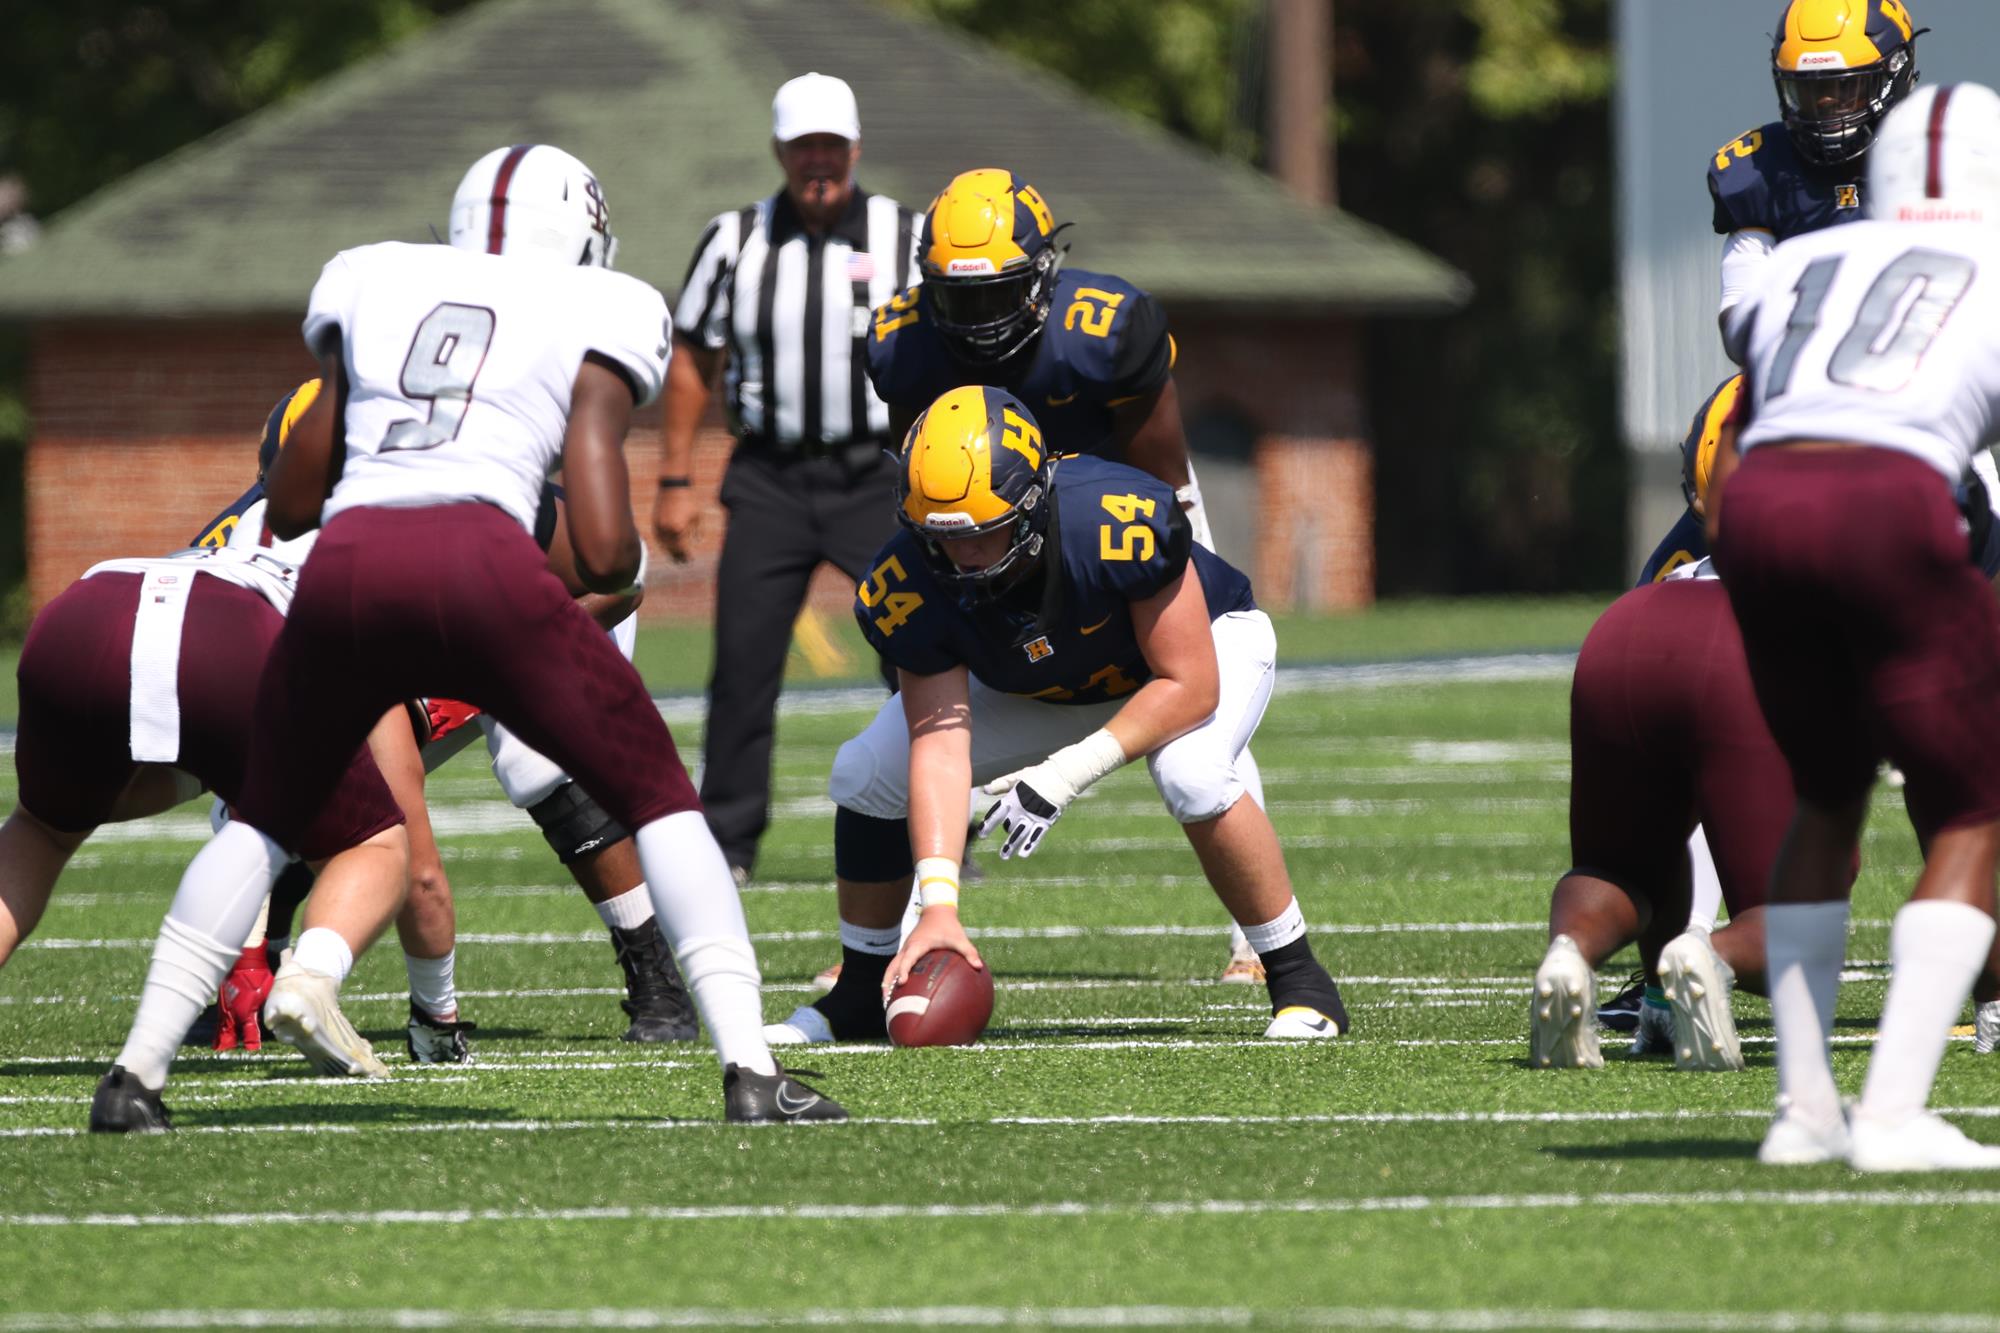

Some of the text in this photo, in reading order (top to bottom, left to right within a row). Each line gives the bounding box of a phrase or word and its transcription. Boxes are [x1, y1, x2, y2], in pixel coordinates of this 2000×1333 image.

[1836, 185, 1858, 208] H
[952, 262, 987, 271] Riddell
[875, 286, 919, 342] 21
[1064, 287, 1126, 338] 21
[1764, 245, 1979, 401] 10
[376, 301, 496, 454] 9
[1001, 407, 1042, 472] H
[1099, 492, 1156, 561] 54
[858, 554, 925, 638] 54
[1024, 636, 1054, 663] H
